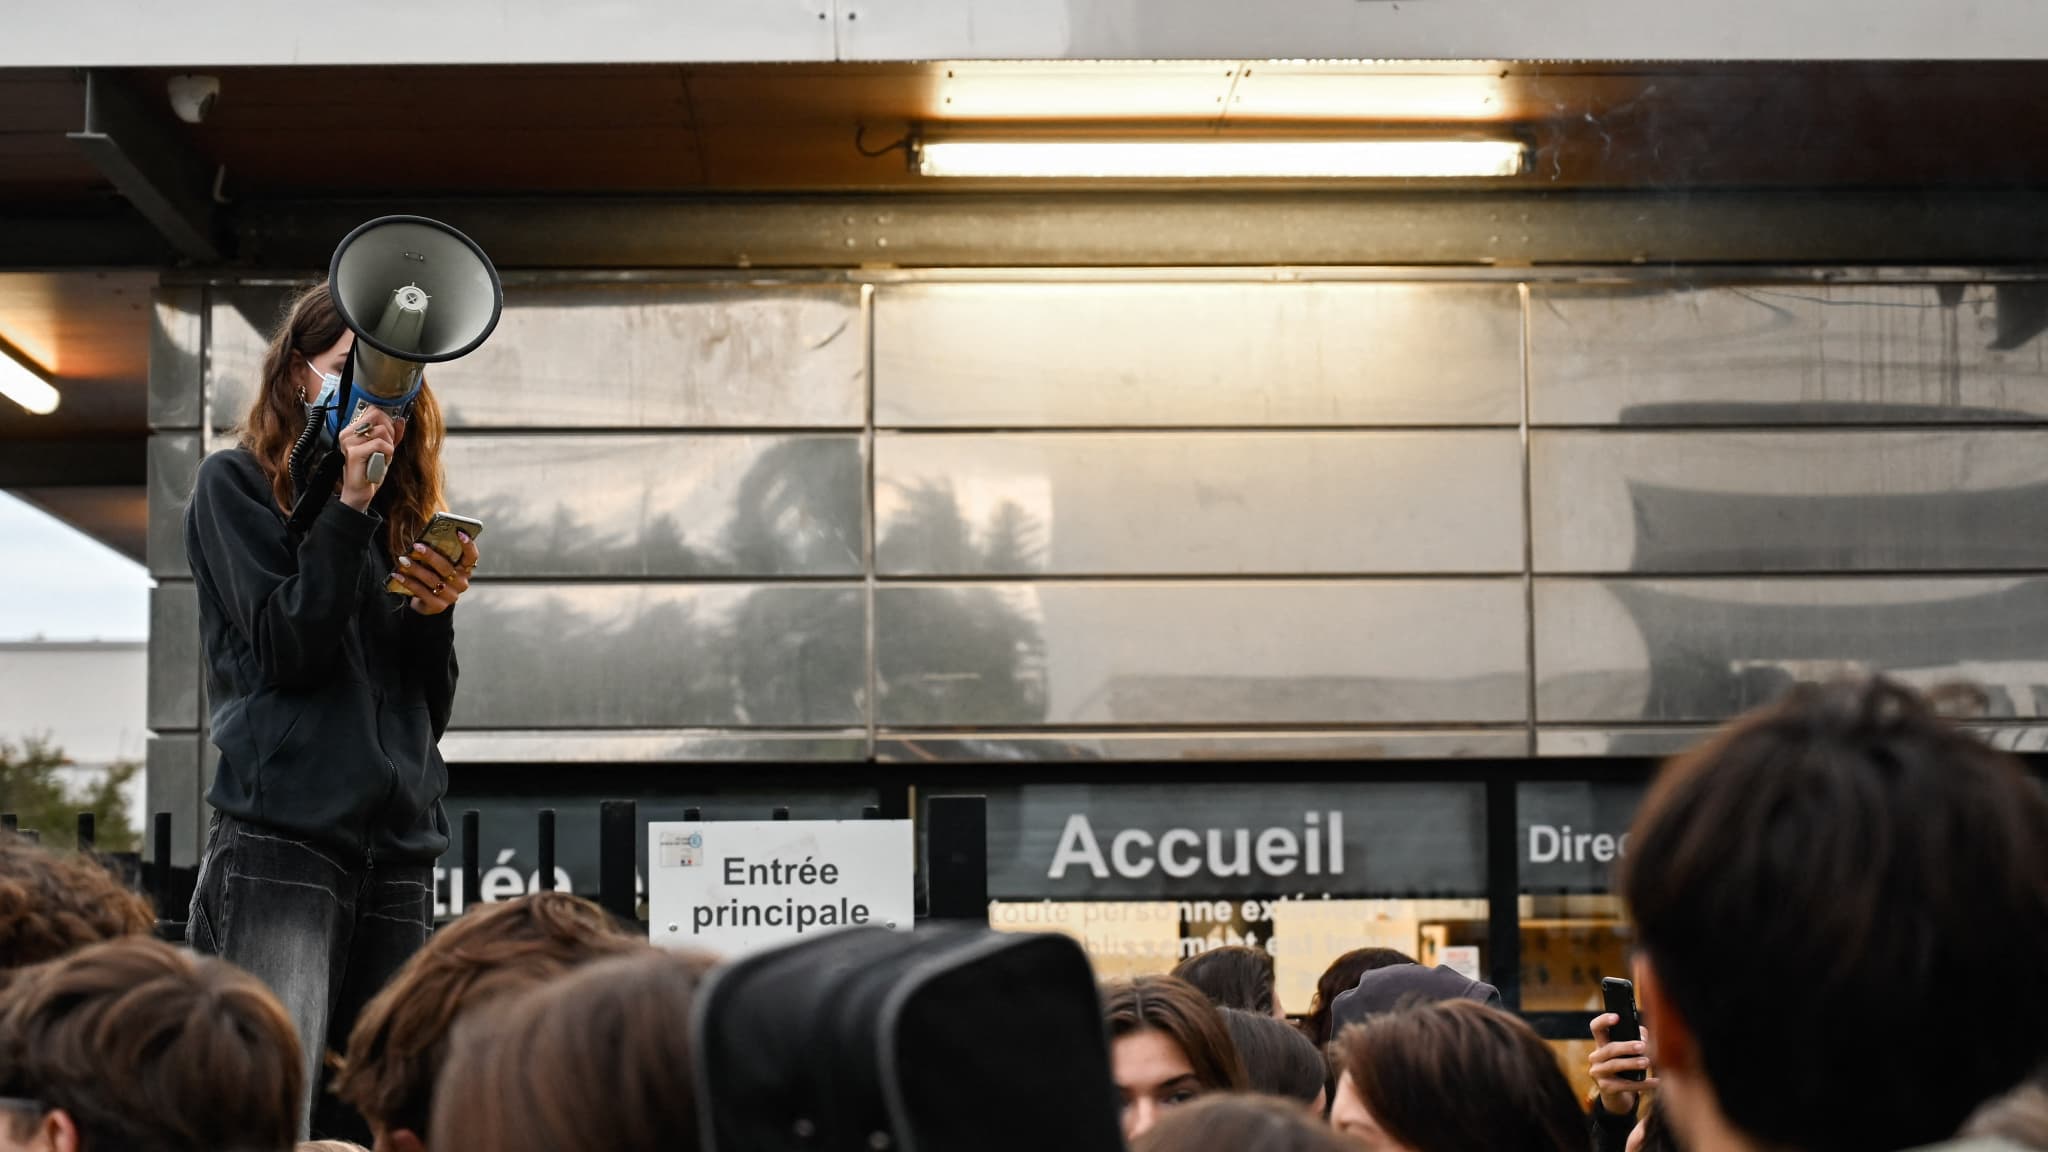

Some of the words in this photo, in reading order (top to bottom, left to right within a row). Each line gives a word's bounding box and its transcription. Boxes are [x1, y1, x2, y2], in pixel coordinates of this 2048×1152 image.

[1047, 811, 1344, 878] Accueil
[723, 856, 839, 886] Entrée
[693, 897, 870, 935] principale
[989, 898, 1070, 923] toute
[1083, 900, 1233, 928] personne
